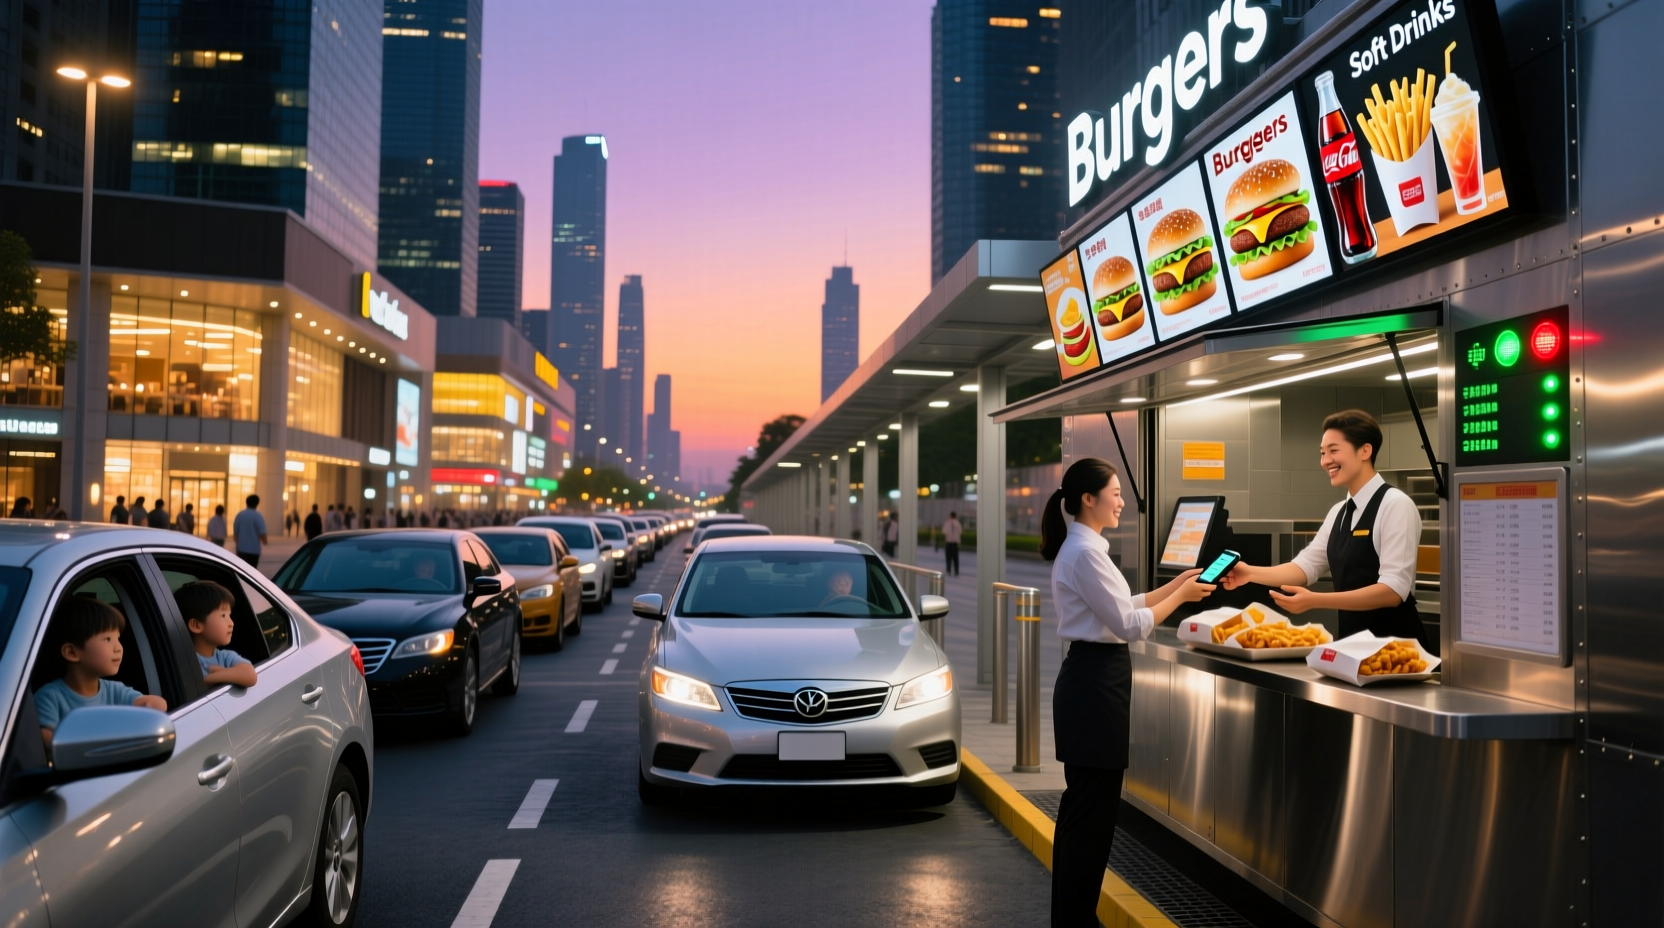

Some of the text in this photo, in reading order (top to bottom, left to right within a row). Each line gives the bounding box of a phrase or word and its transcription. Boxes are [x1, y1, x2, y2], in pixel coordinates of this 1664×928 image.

[1067, 0, 1268, 208] Burgers
[1349, 0, 1456, 79] Soft Drinks
